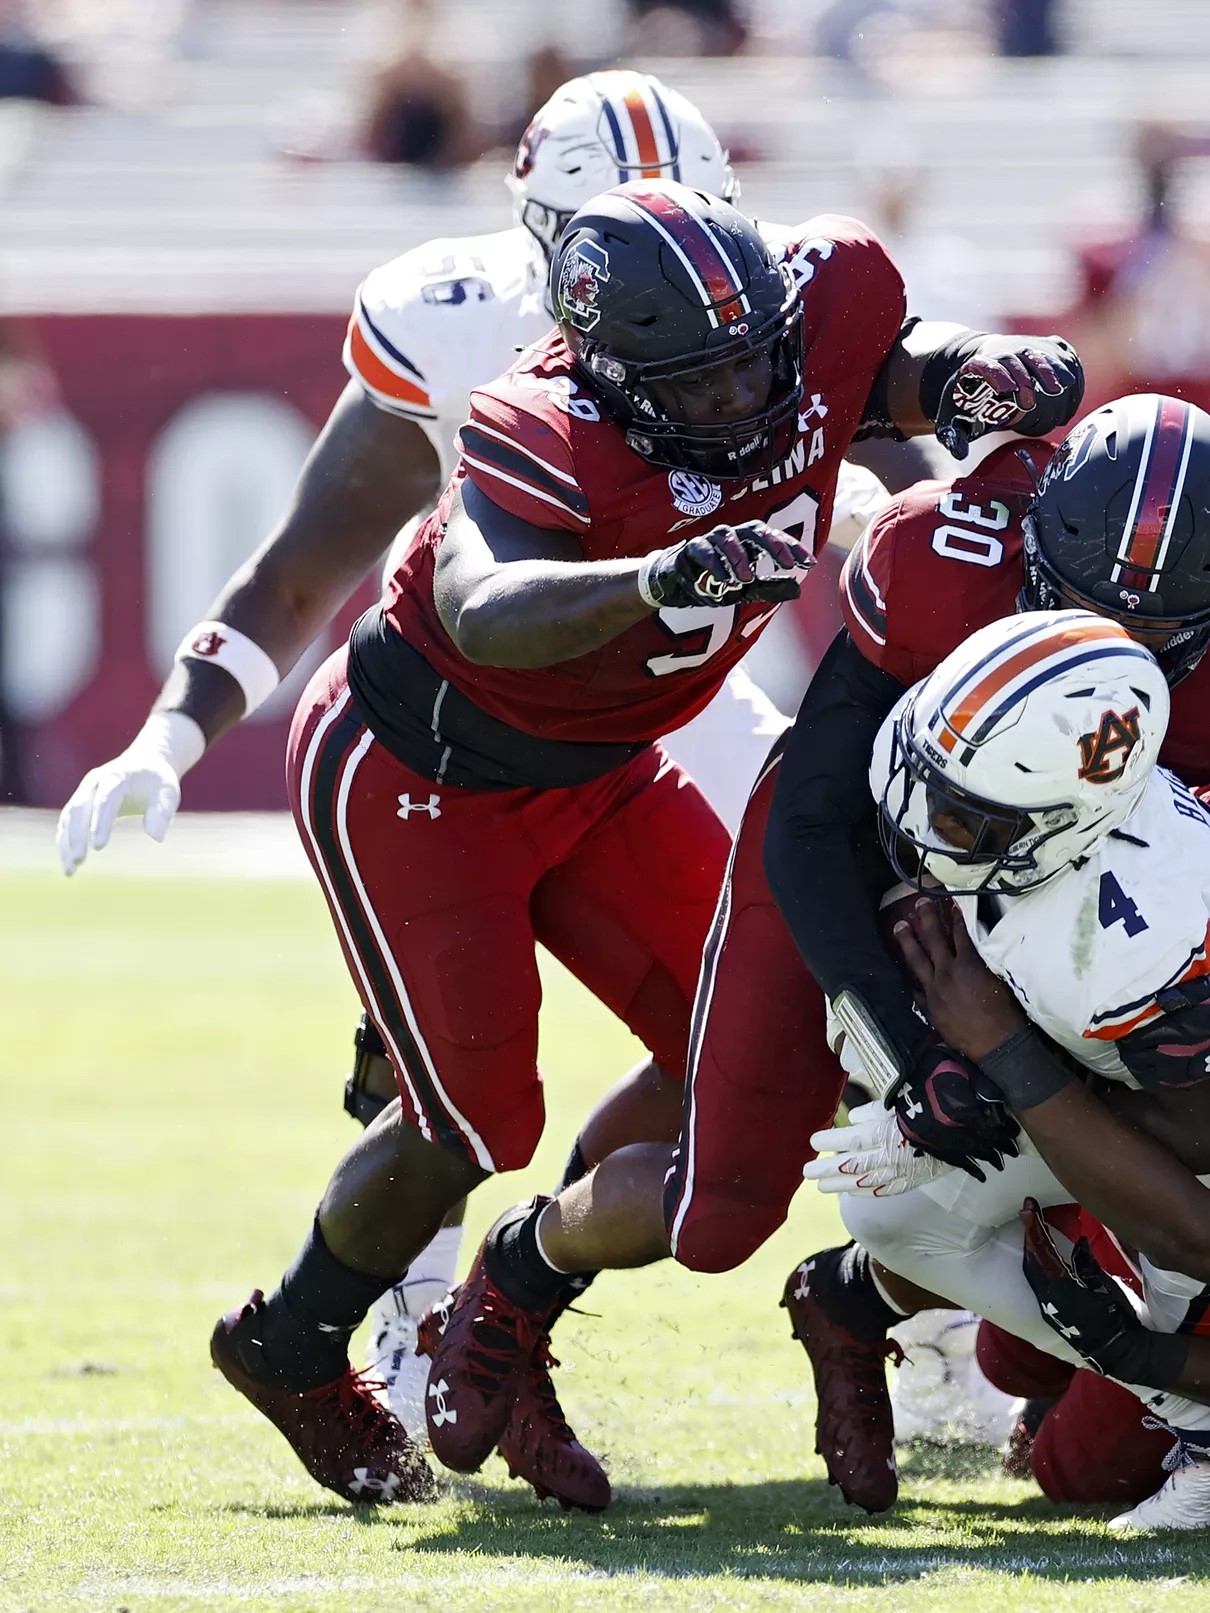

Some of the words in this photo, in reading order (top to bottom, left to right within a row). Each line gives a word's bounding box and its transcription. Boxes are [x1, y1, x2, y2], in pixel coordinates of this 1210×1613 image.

[727, 433, 762, 461] Rddell
[682, 493, 721, 516] GRADUATE
[931, 492, 1010, 568] 30
[922, 738, 949, 769] TIGERS
[1098, 871, 1150, 938] 4
